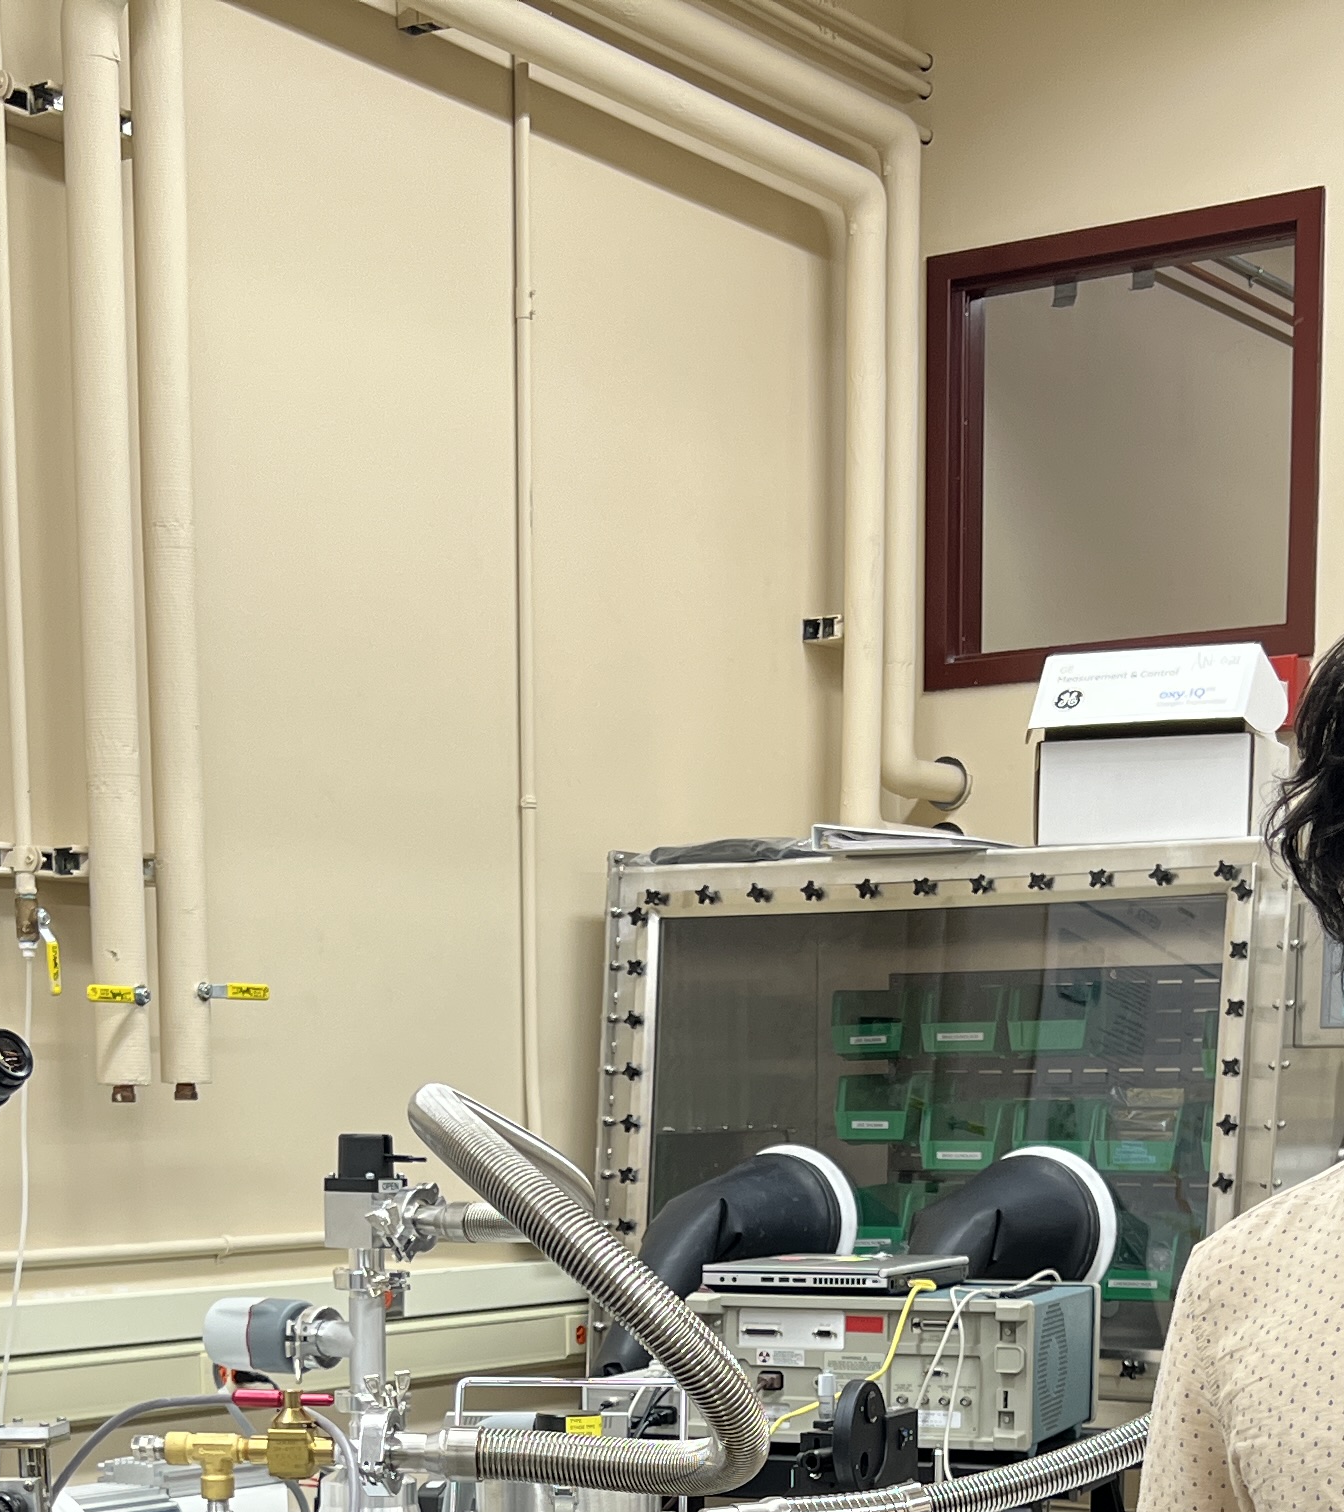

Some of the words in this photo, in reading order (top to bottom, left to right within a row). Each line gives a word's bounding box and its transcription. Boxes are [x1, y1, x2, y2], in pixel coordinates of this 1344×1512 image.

[1057, 671, 1128, 684] Measurement
[1130, 671, 1138, 679] &
[1140, 667, 1181, 679] Control
